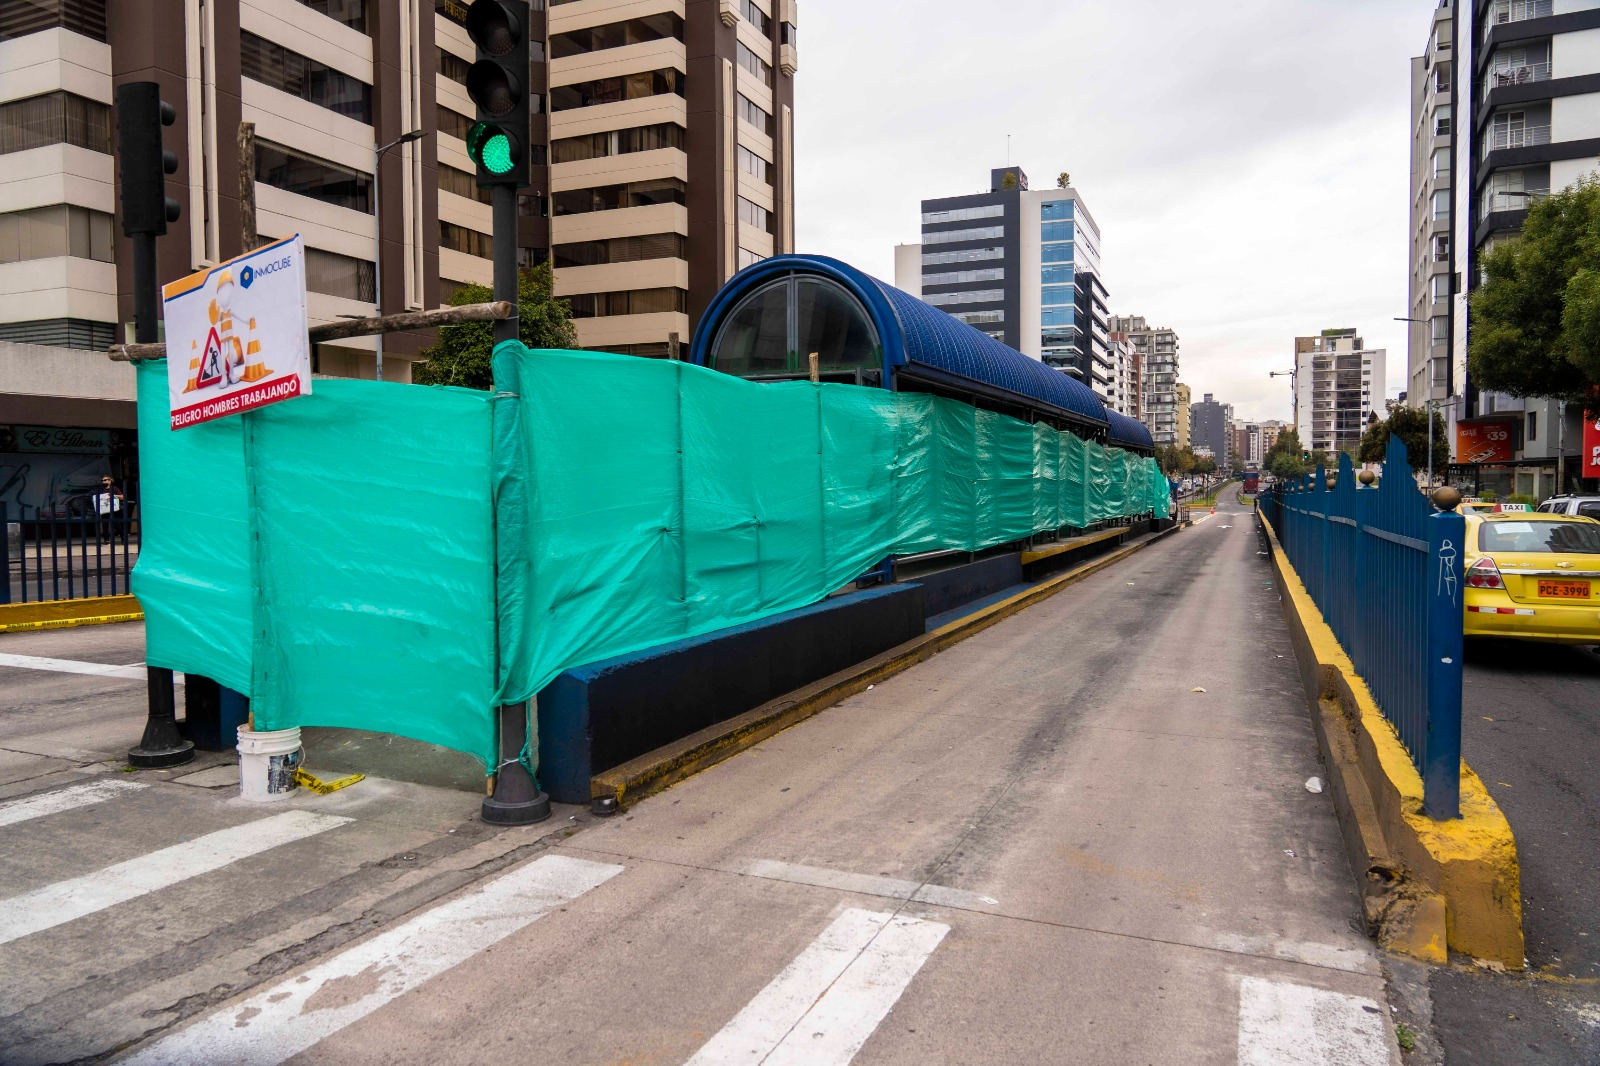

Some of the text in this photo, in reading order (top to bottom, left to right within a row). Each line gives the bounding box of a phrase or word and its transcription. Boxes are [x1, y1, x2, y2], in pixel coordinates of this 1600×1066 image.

[254, 255, 291, 279] INMOCUBE
[171, 379, 297, 427] PELIGRO HOMBRES TRABAJANDO
[24, 430, 51, 448] El
[1487, 430, 1508, 441] $39
[1540, 585, 1589, 597] PCE-3990
